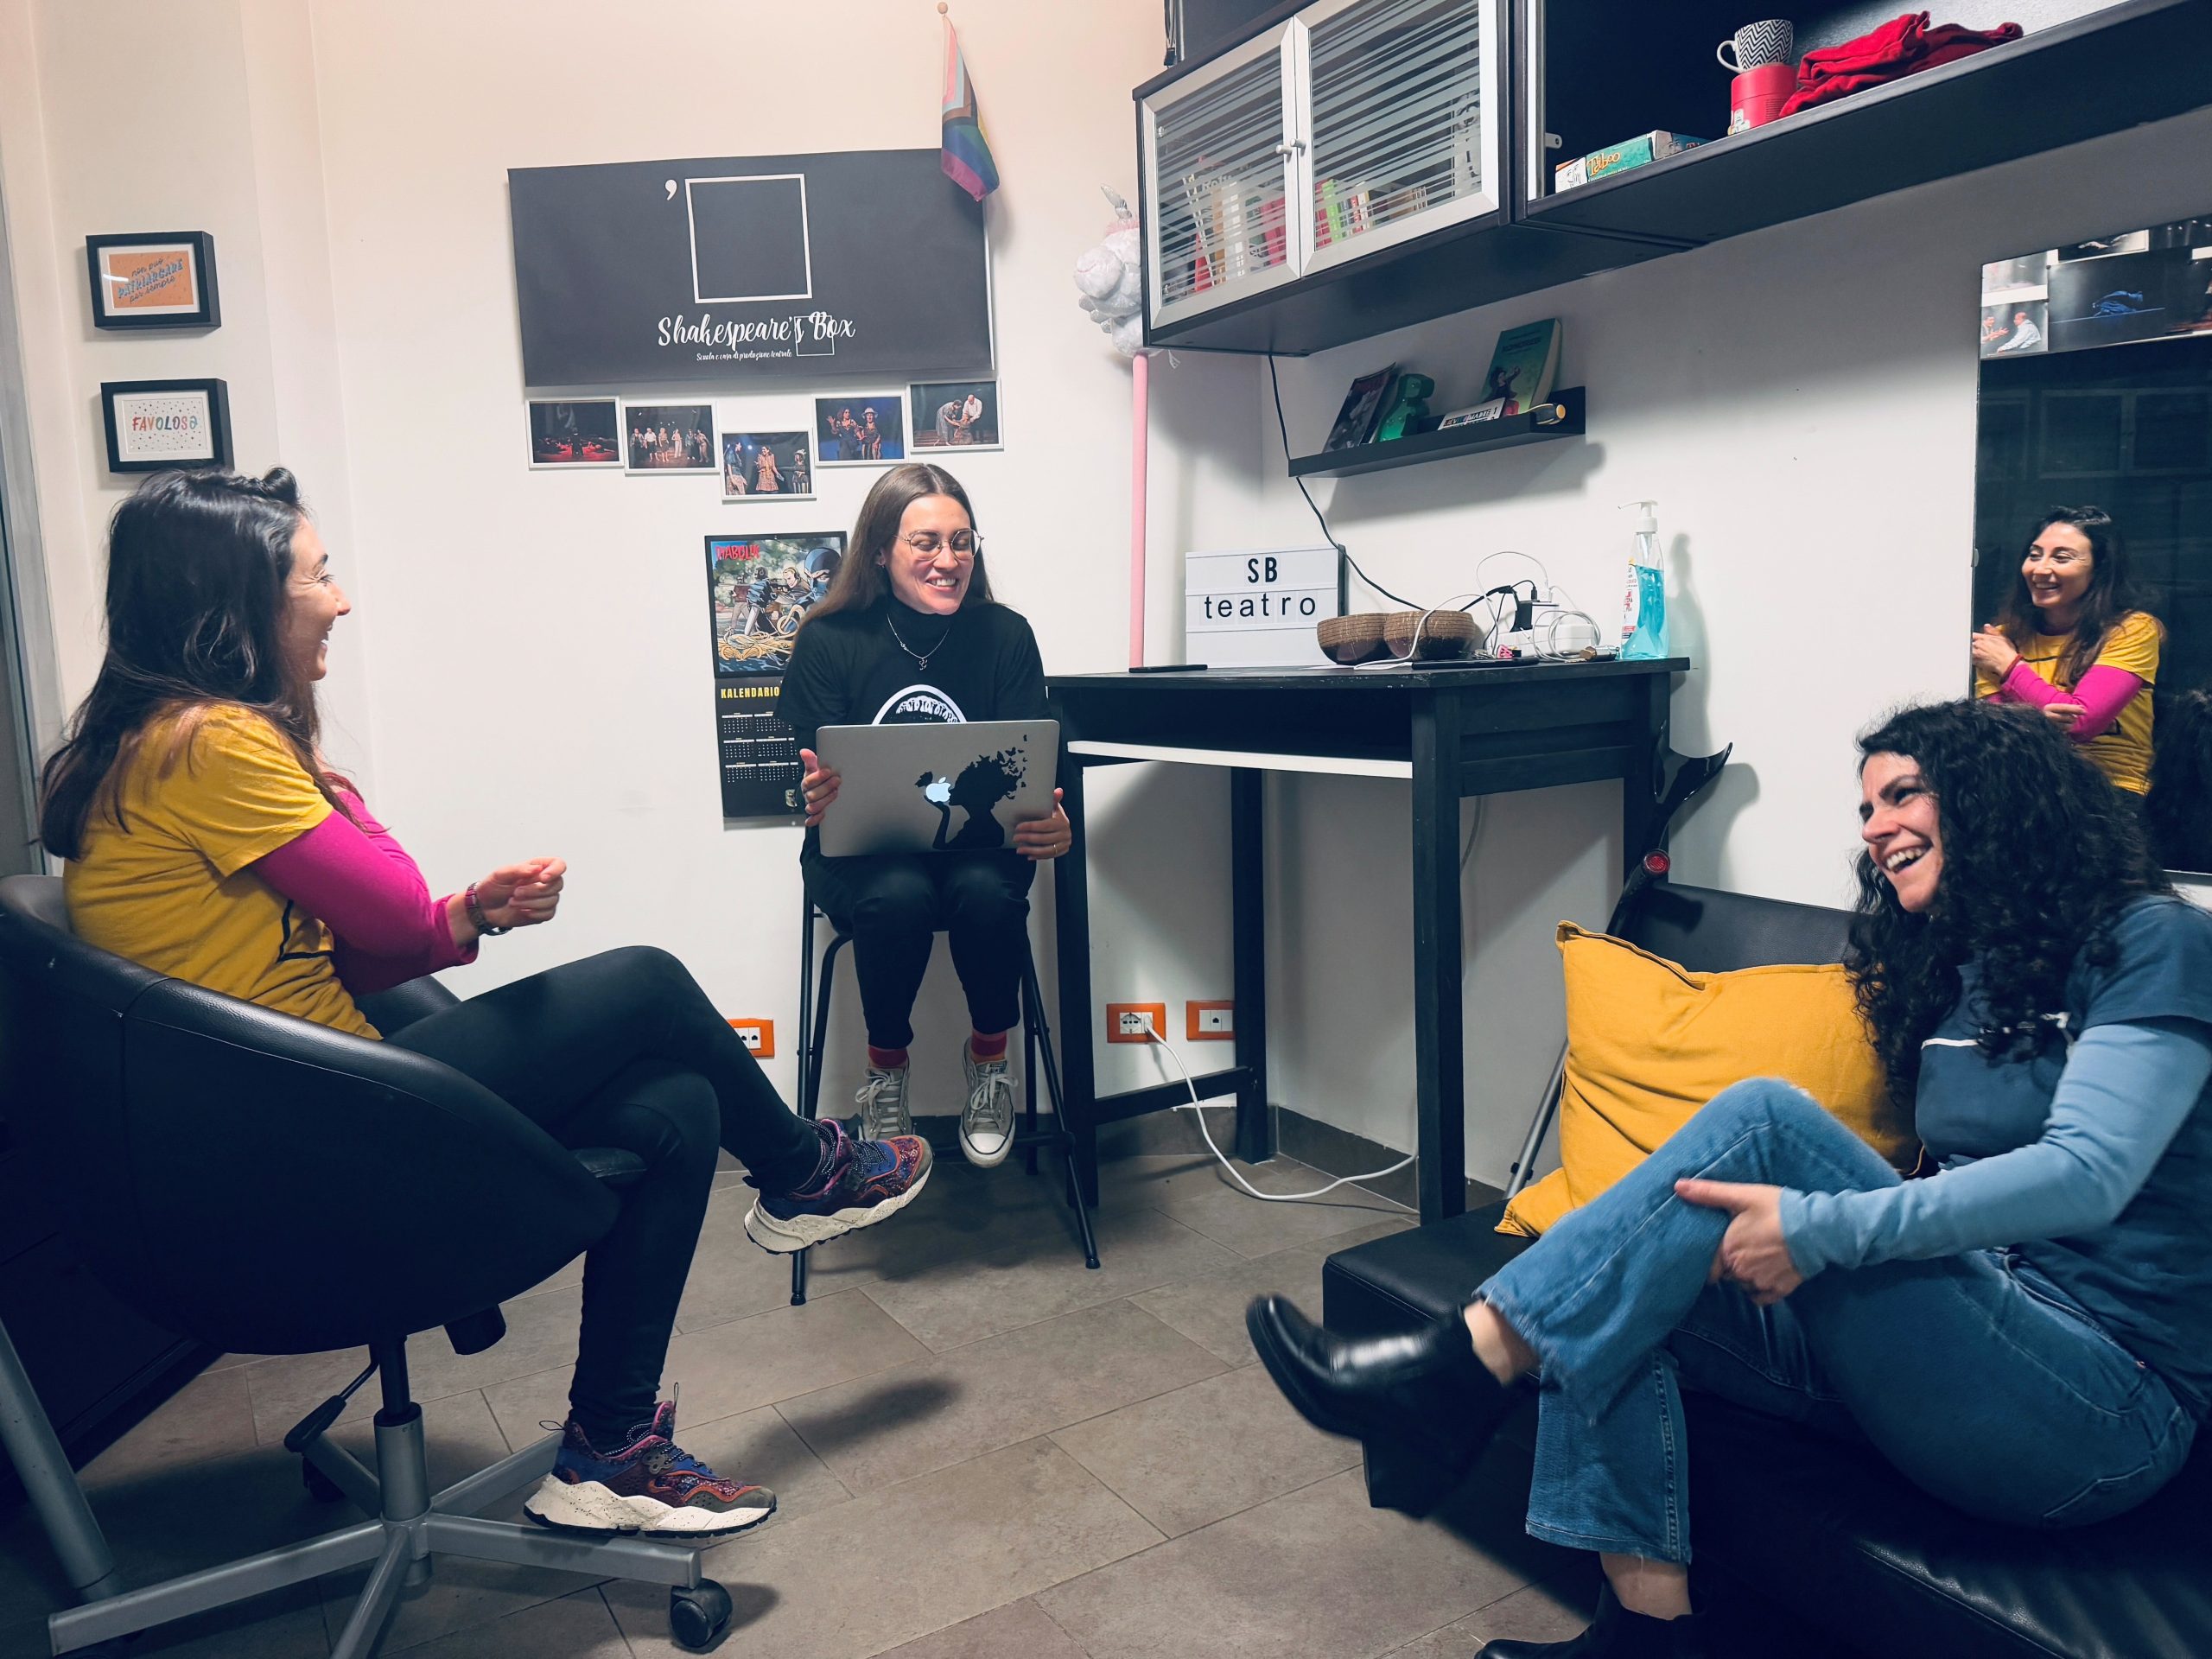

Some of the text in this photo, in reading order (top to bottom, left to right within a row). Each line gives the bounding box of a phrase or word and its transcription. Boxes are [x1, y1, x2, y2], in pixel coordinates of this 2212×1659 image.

[1586, 152, 1621, 177] Taboo
[658, 311, 856, 352] Shakespeare's Box
[739, 350, 770, 362] produzione
[771, 348, 792, 358] teatrale
[715, 543, 760, 561] DIABOLIK
[1247, 556, 1278, 583] SB
[1204, 592, 1316, 620] teatro
[721, 686, 780, 699] KALENDARIO
